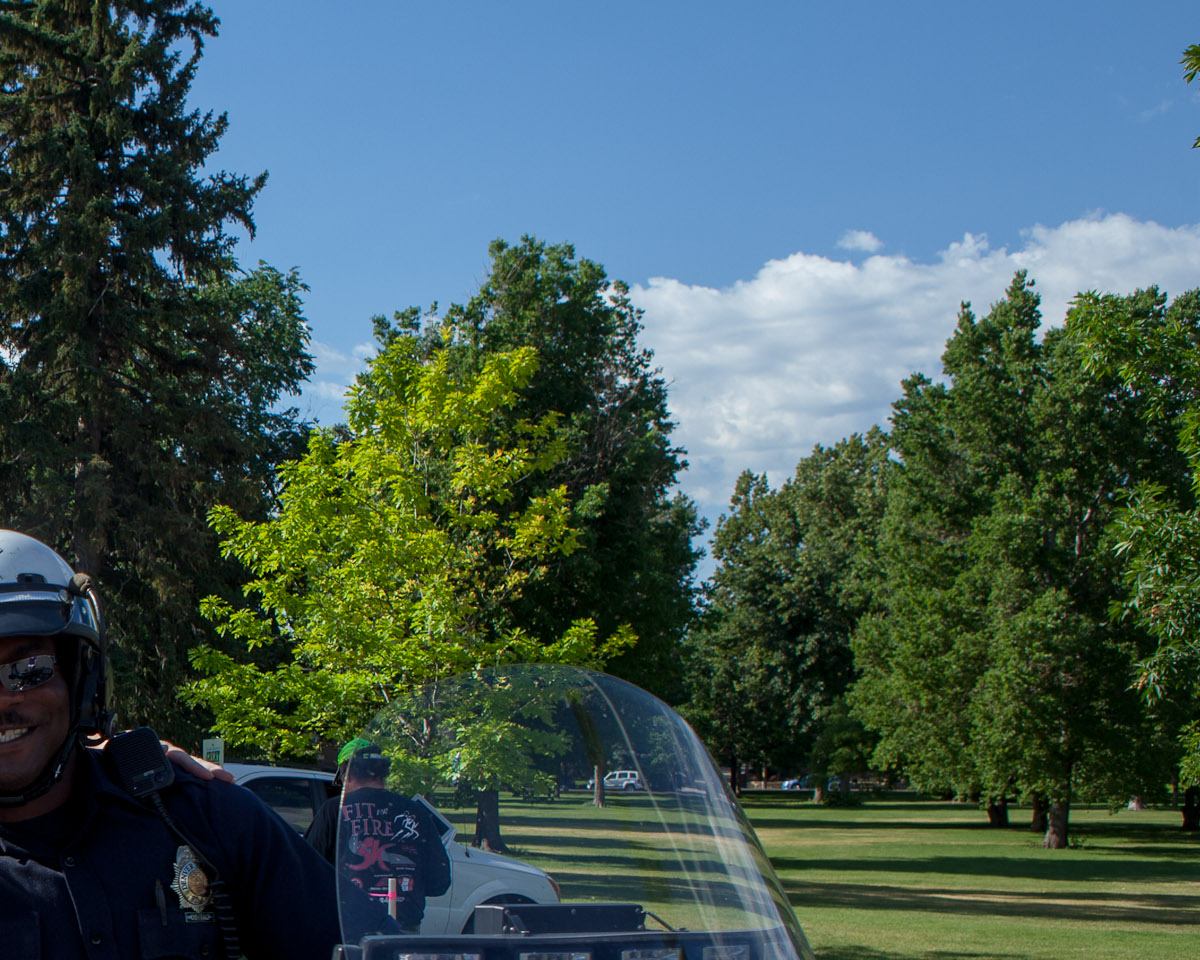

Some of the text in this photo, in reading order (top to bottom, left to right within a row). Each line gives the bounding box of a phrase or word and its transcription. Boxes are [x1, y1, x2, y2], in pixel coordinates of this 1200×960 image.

[342, 802, 376, 822] FIT
[351, 818, 394, 837] FIRE
[348, 836, 397, 872] 5K
